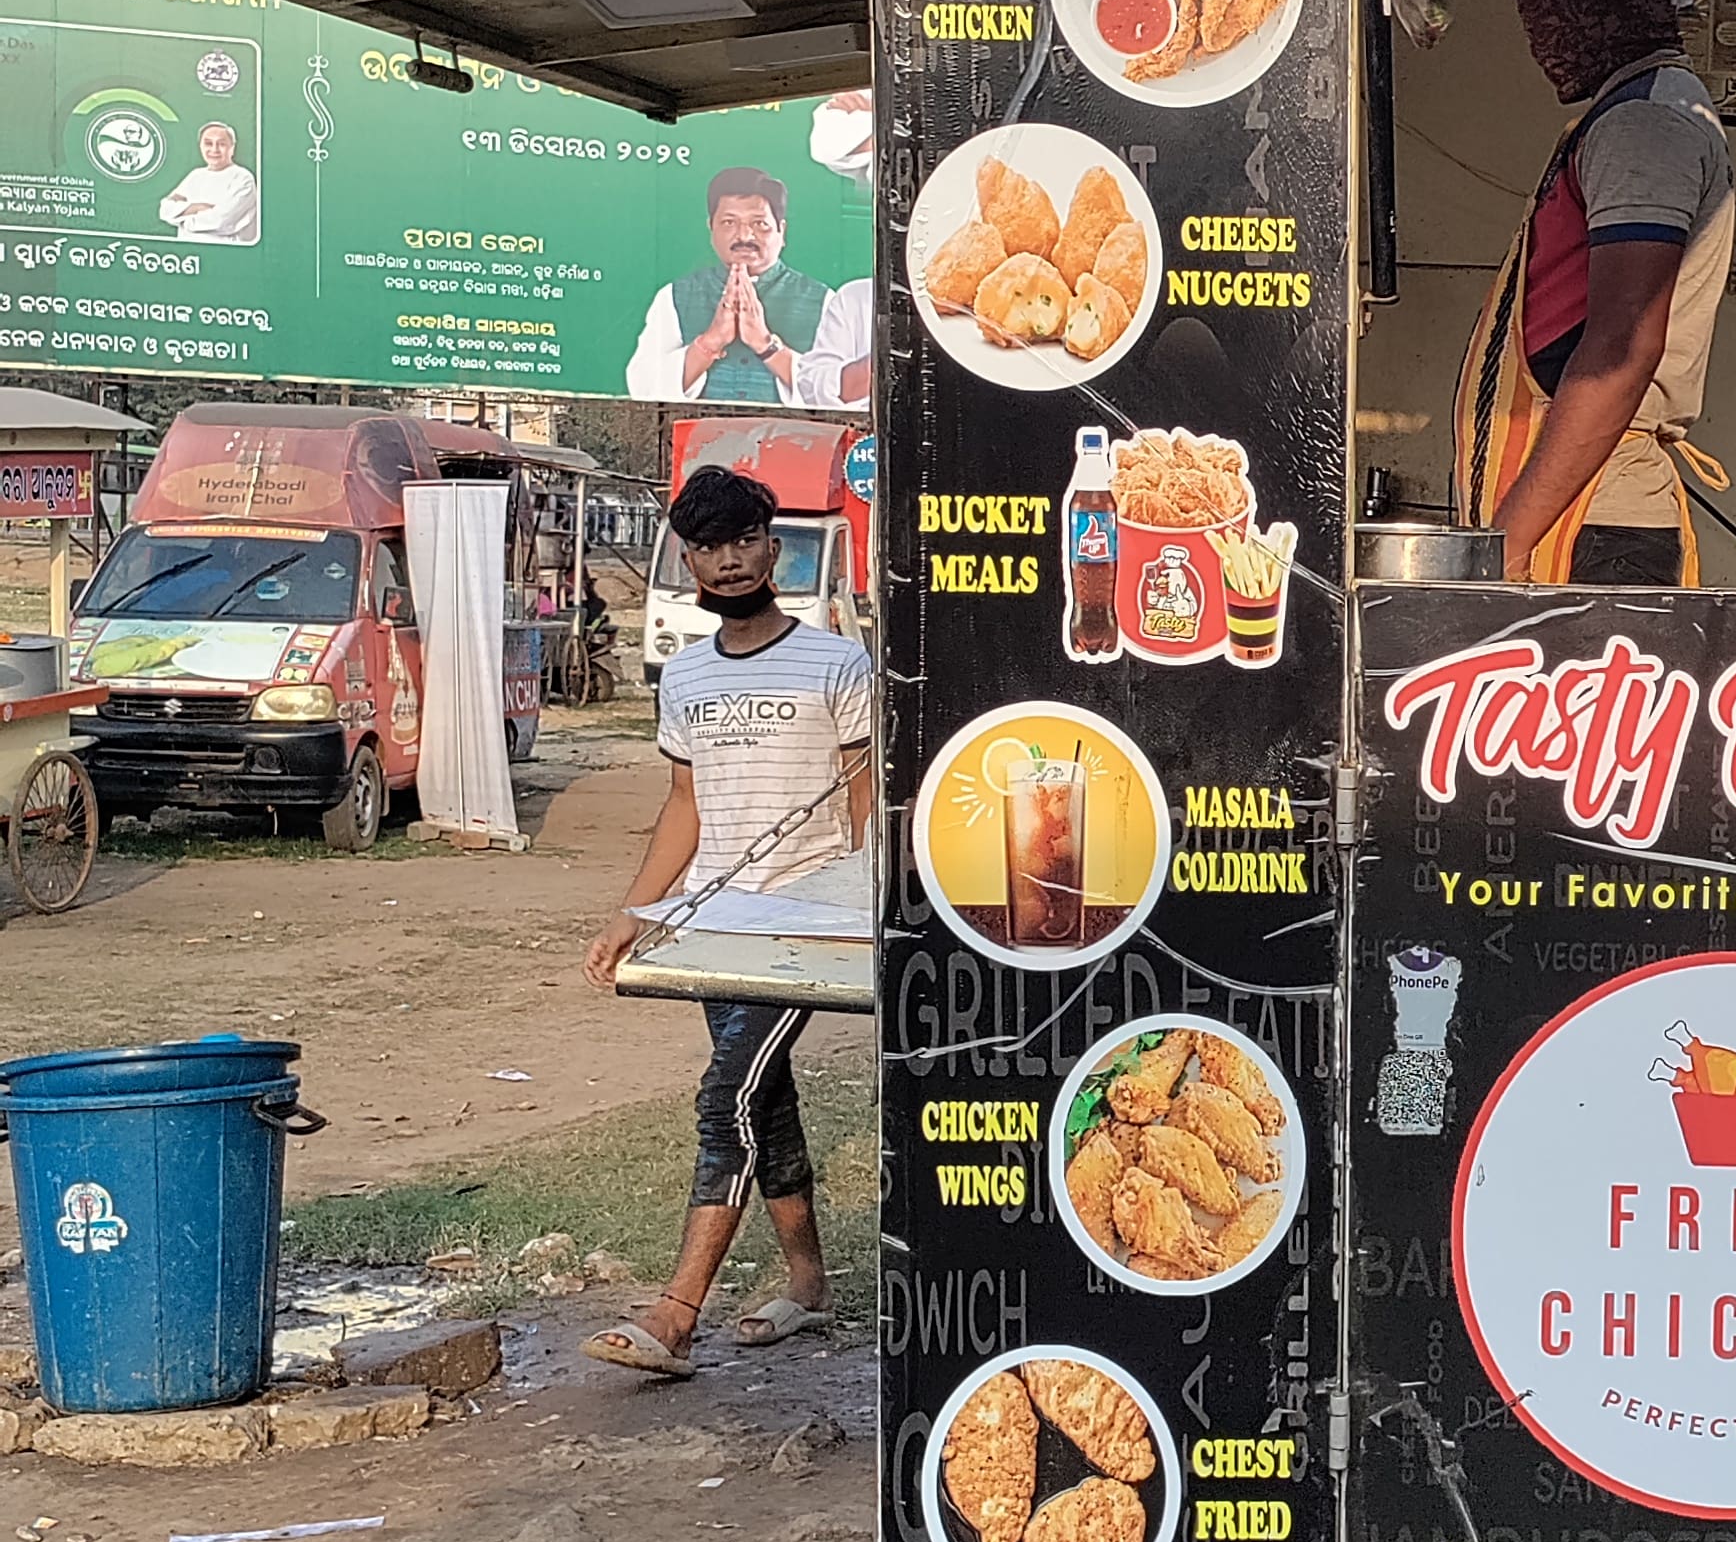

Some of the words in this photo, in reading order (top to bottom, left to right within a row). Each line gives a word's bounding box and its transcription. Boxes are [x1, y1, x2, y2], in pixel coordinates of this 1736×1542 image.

[921, 2, 1035, 42] CHICKEN
[461, 129, 502, 152] ୧୩
[508, 127, 607, 160] ଡିସେମ୍ବର
[616, 141, 692, 165] ୨୦୨୧
[0, 174, 47, 184] vernment
[61, 175, 95, 187] Odisha
[7, 200, 51, 215] Kalyan
[53, 203, 96, 218] Yojana
[403, 227, 473, 249] ପ୍ରତାପ
[480, 233, 545, 254] ଜେନା
[1181, 214, 1298, 254] CHEESE
[122, 245, 201, 275] ବିତରଣ
[18, 294, 69, 315] କଟକ
[1166, 268, 1312, 309] NUGGETS
[51, 330, 137, 354] ଧନ୍ୟବାଦ
[198, 476, 307, 493] Hyderabadi
[917, 493, 1052, 536] BUCKET
[929, 553, 1040, 595] MEALS
[685, 693, 798, 727] MEXICO
[1385, 632, 1698, 848] Tasty
[1183, 785, 1296, 830] MASALA
[1171, 850, 1309, 895] COLDRINK
[1438, 870, 1543, 908] Your
[1390, 974, 1450, 989] PhonePe
[920, 1099, 1041, 1143] CHICKEN
[935, 1164, 1027, 1207] WINGS
[1190, 1437, 1296, 1480] CHEST
[1193, 1499, 1293, 1542] FRIED
